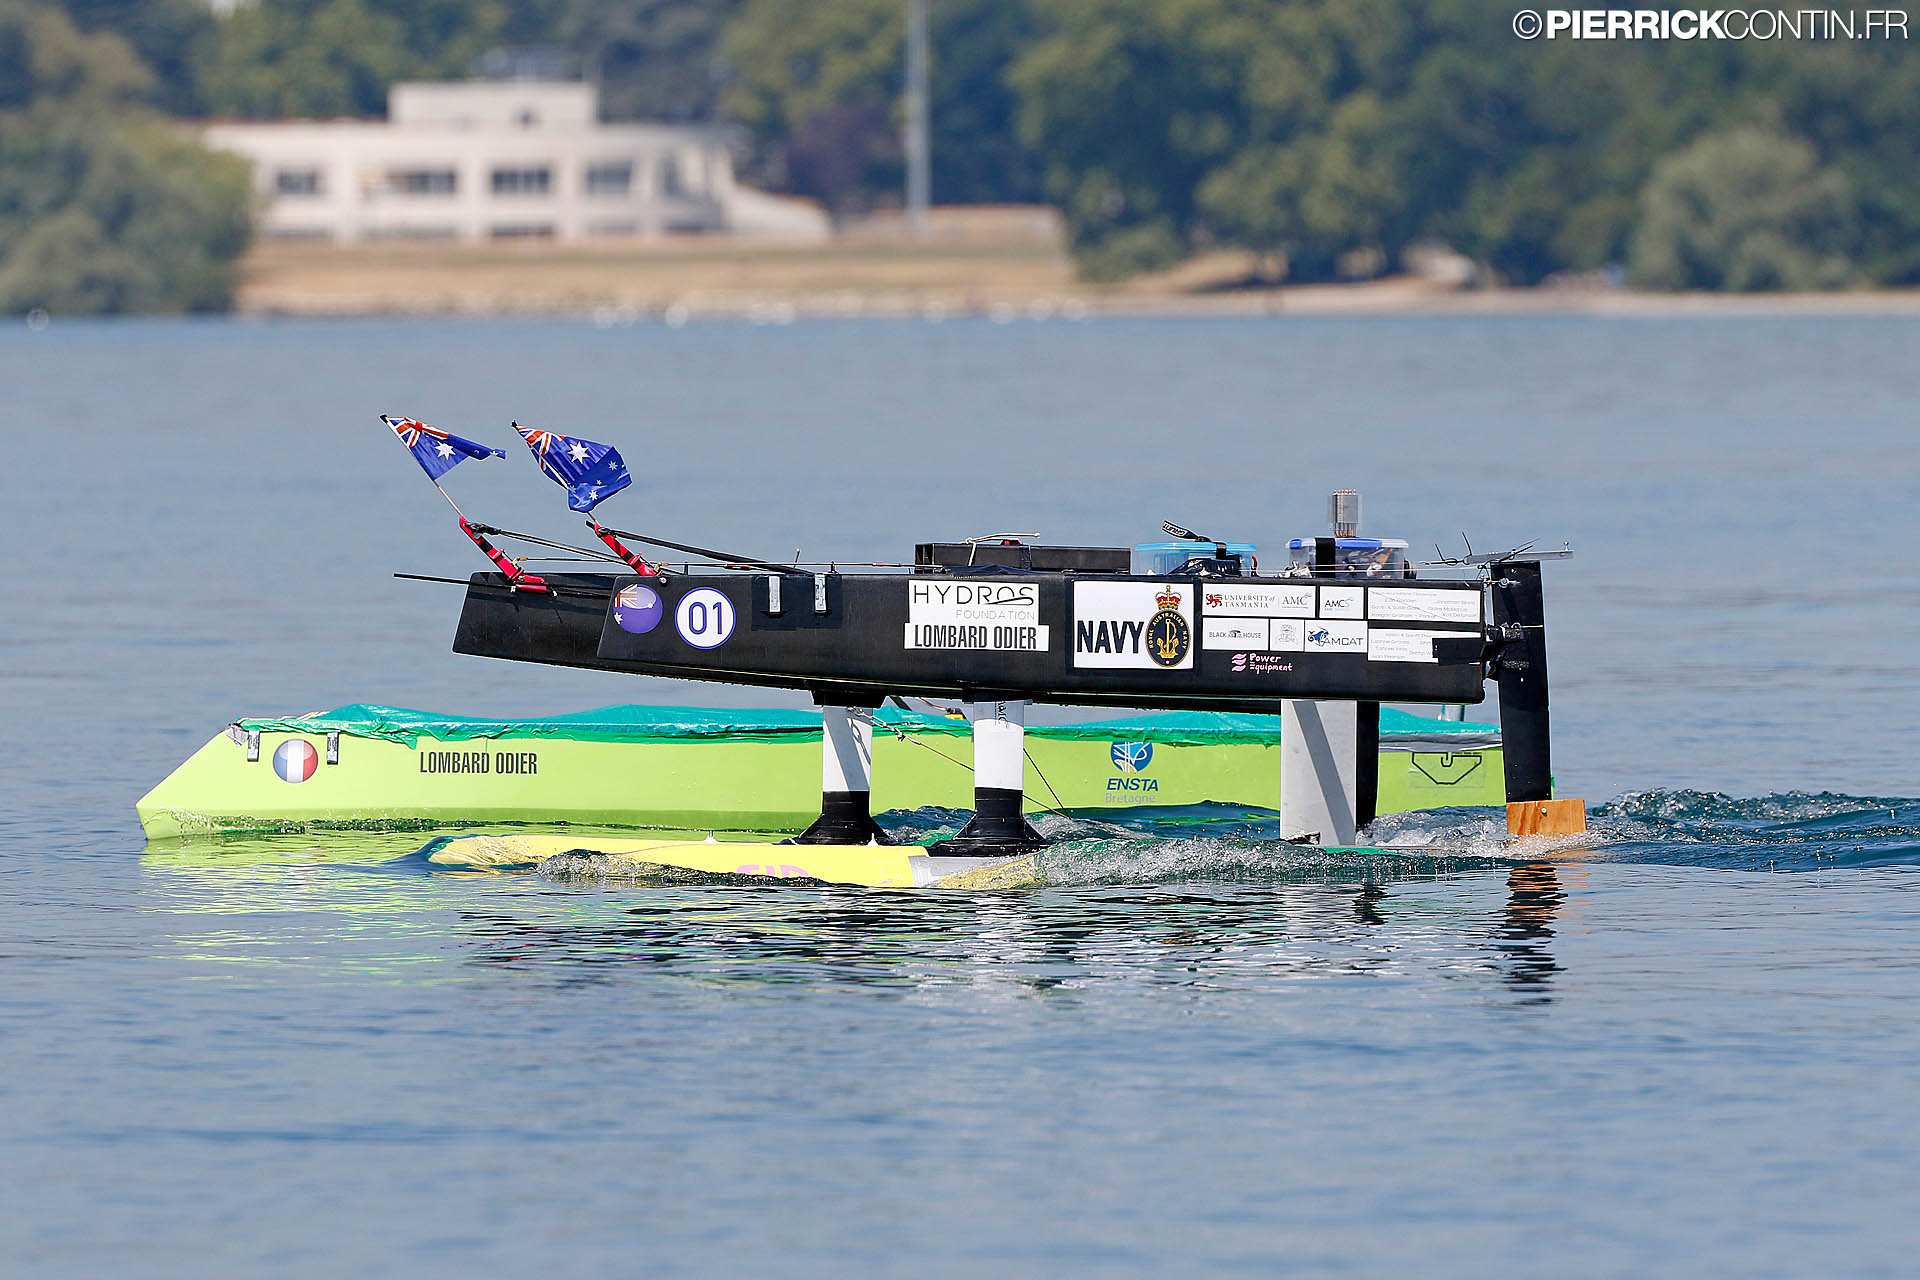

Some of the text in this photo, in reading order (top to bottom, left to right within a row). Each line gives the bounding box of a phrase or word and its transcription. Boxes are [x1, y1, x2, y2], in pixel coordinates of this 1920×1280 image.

[913, 584, 1035, 606] HYDROS
[1224, 594, 1268, 602] UNIVERSITY
[1281, 594, 1308, 606] AMC
[687, 601, 723, 635] 01
[955, 609, 1035, 621] FOUNDATION
[1152, 612, 1185, 627] AUSTRALIAN
[914, 624, 1037, 650] LOMBARD ODIER
[1076, 619, 1145, 654] NAVY
[1249, 653, 1281, 662] Power
[1249, 661, 1293, 674] Equipment
[420, 751, 538, 774] LOMBARD ODIER
[1106, 777, 1159, 792] ENSTA
[1105, 792, 1156, 804] Bretagne
